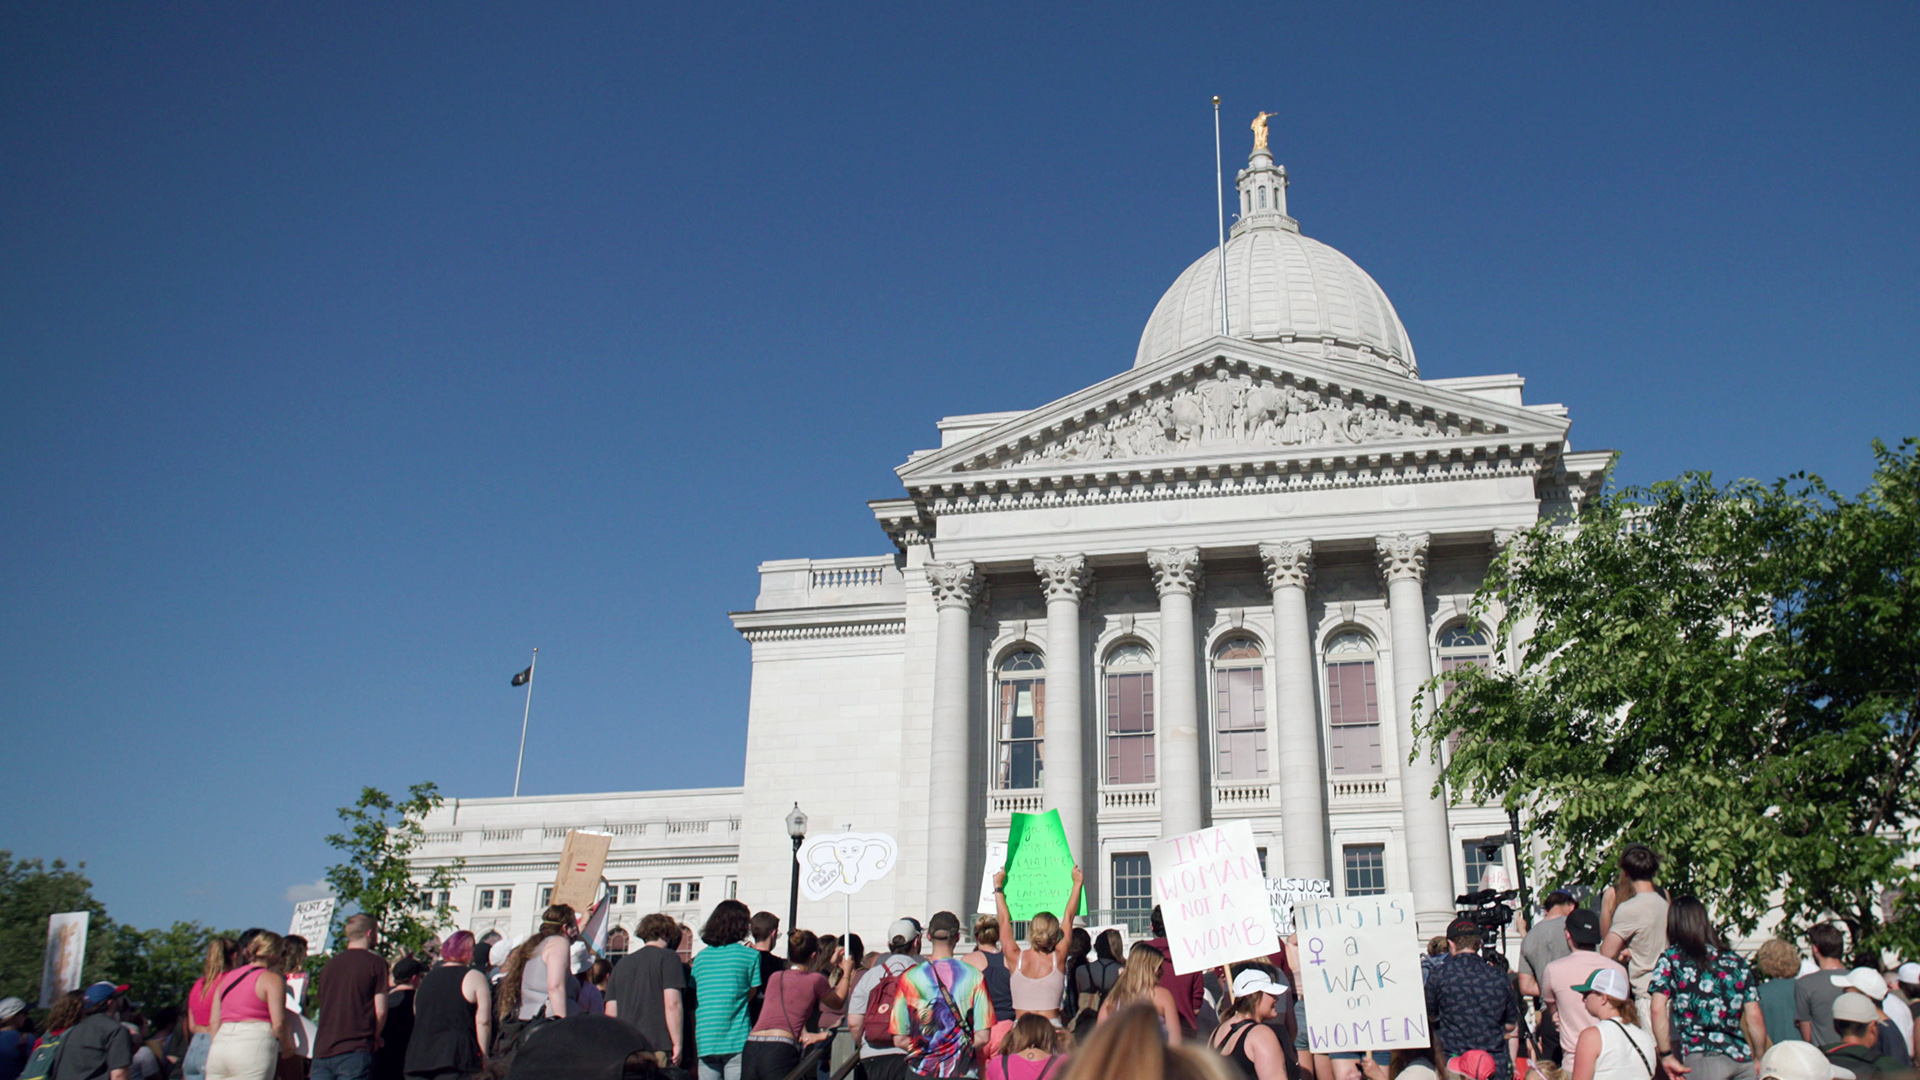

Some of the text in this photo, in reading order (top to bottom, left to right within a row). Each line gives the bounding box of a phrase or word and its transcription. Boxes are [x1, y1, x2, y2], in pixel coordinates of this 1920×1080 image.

[1158, 853, 1260, 901] WOMAN
[1298, 878, 1329, 893] JUST
[1181, 893, 1235, 921] NOT A
[1182, 916, 1266, 959] WOMB
[1343, 936, 1359, 956] a
[1322, 961, 1397, 993] WAR
[1347, 994, 1371, 1010] on
[1309, 1013, 1426, 1049] WOMEN
